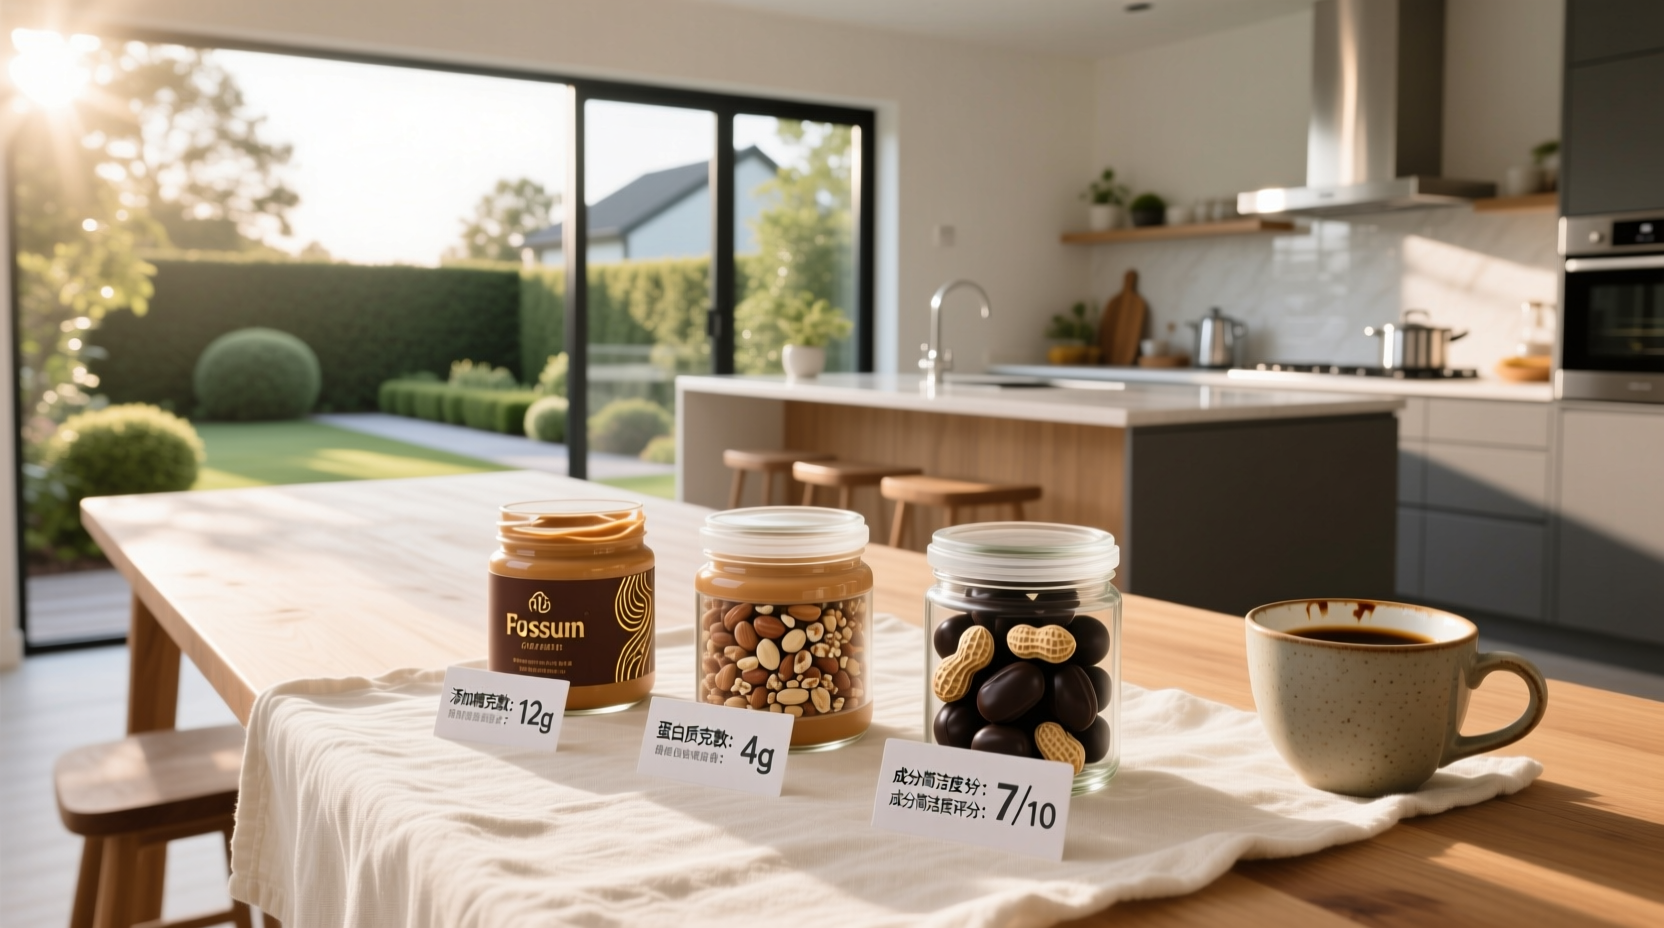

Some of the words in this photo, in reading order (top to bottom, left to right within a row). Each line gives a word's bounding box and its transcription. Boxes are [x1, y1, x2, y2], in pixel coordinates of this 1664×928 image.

[519, 699, 554, 734] 12g
[740, 735, 775, 775] 4g
[996, 782, 1057, 829] 7/10
